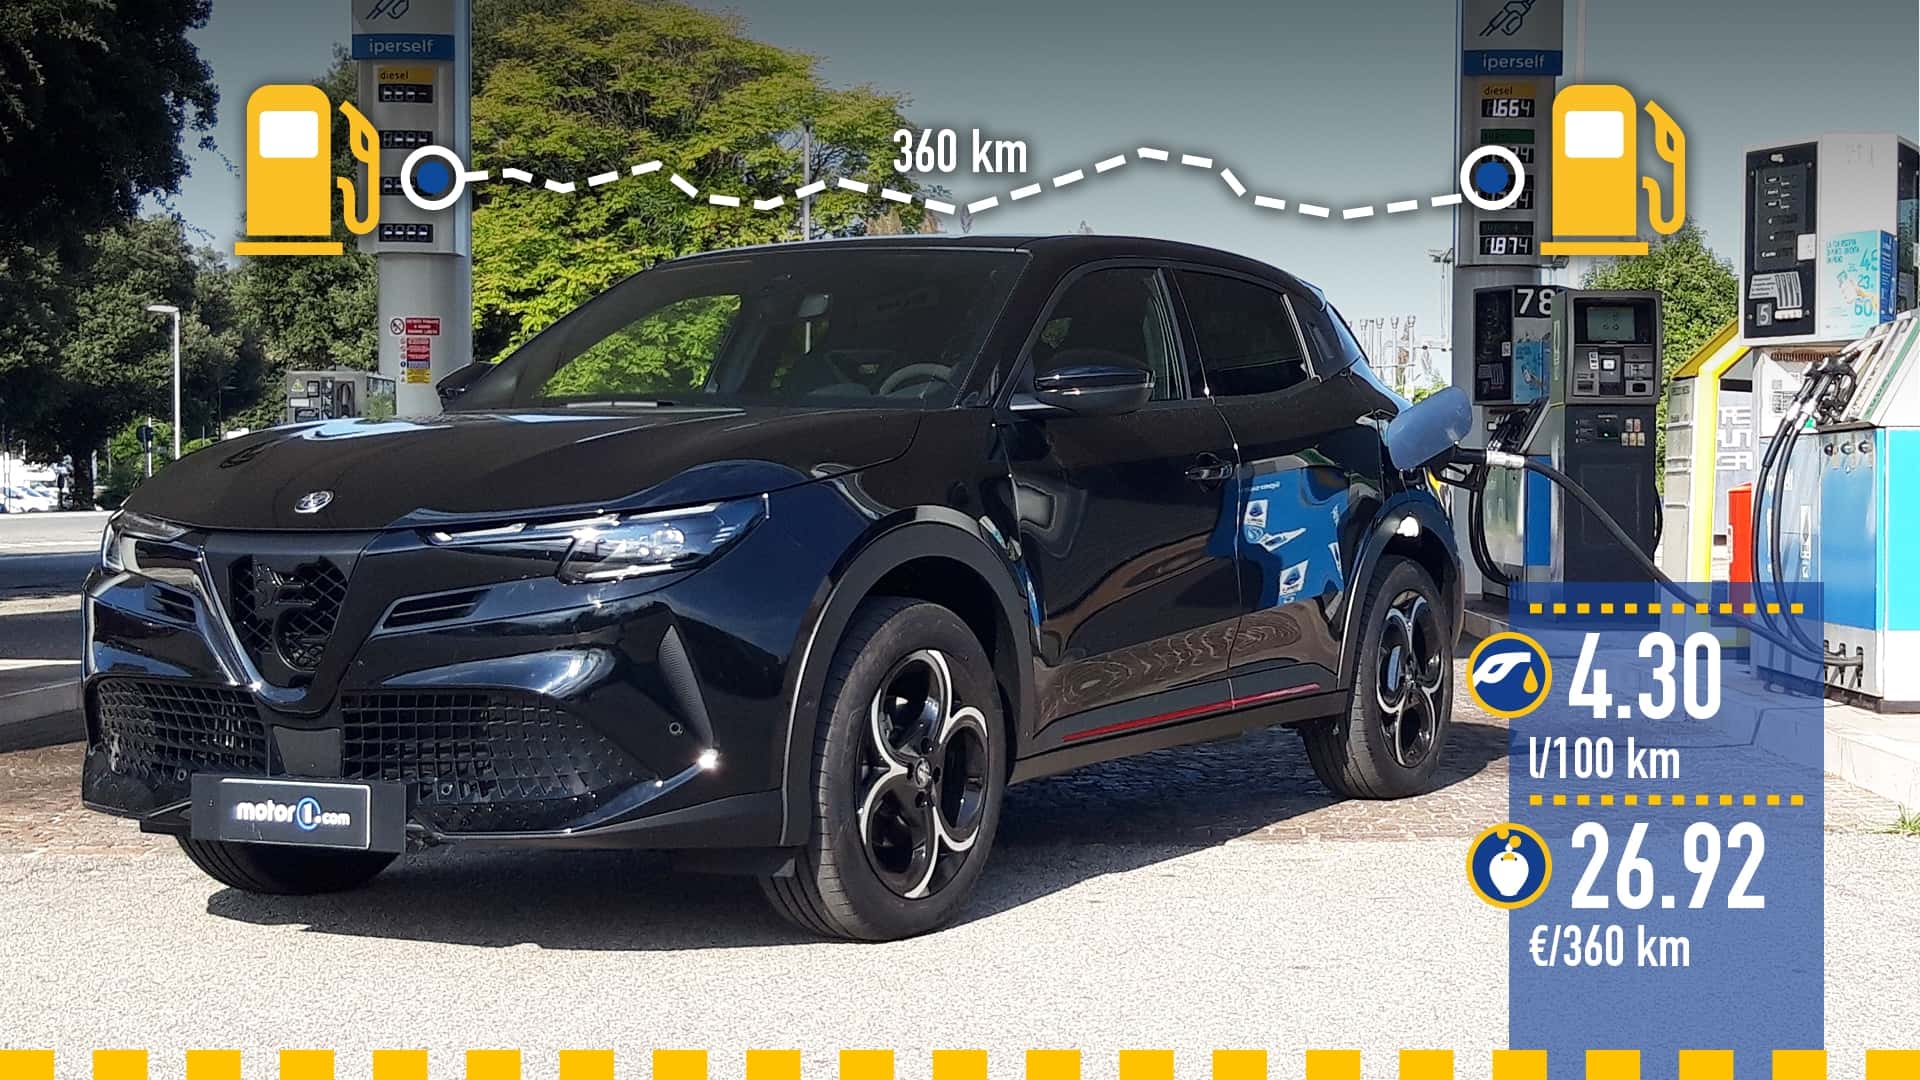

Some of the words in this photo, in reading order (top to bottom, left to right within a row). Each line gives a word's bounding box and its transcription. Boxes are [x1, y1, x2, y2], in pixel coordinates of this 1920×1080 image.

[368, 38, 435, 55] iperself
[1482, 54, 1545, 71] iperself
[380, 70, 410, 81] diesel
[1483, 85, 1514, 96] diesel
[1516, 288, 1555, 315] 78
[1759, 304, 1769, 325] 5
[235, 797, 351, 830] motor1.com
